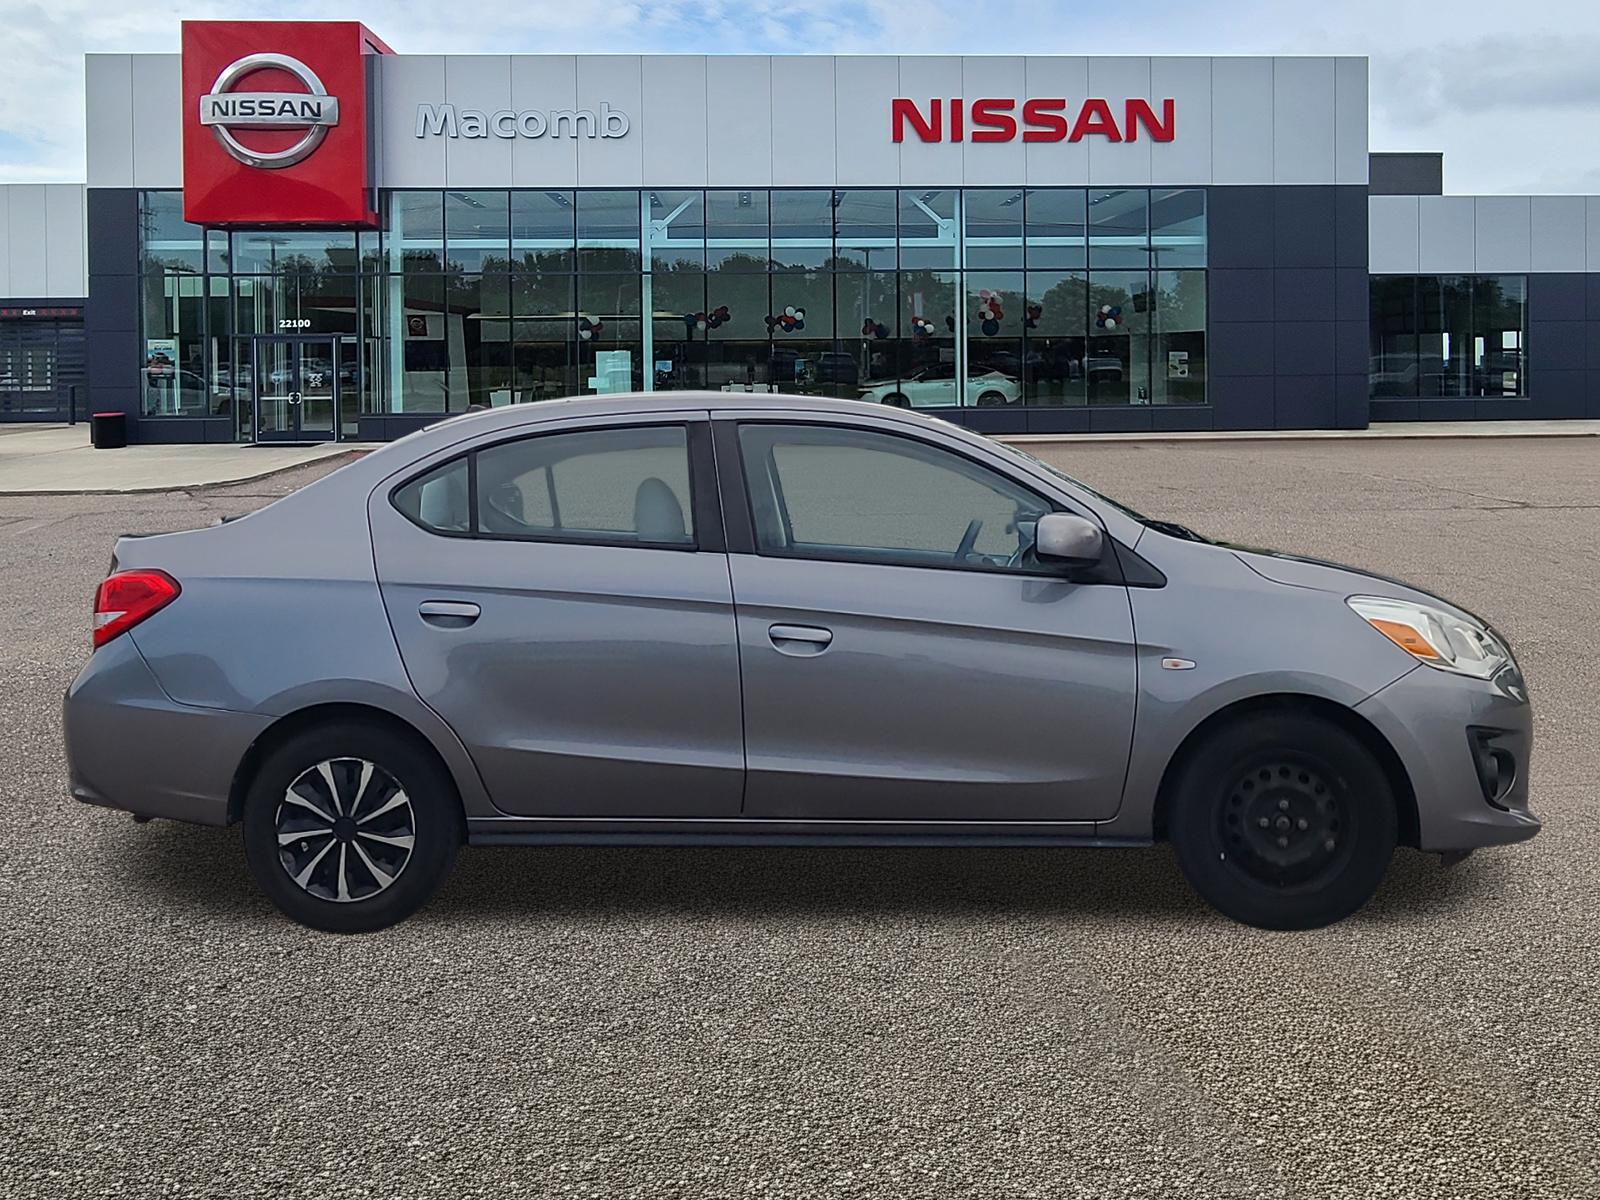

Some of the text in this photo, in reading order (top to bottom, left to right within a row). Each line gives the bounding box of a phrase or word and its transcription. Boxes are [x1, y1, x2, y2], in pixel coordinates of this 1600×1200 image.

[212, 100, 321, 117] NISSAN
[415, 102, 629, 138] Macomb
[892, 98, 1175, 142] NISSAN
[279, 319, 311, 328] 22100
